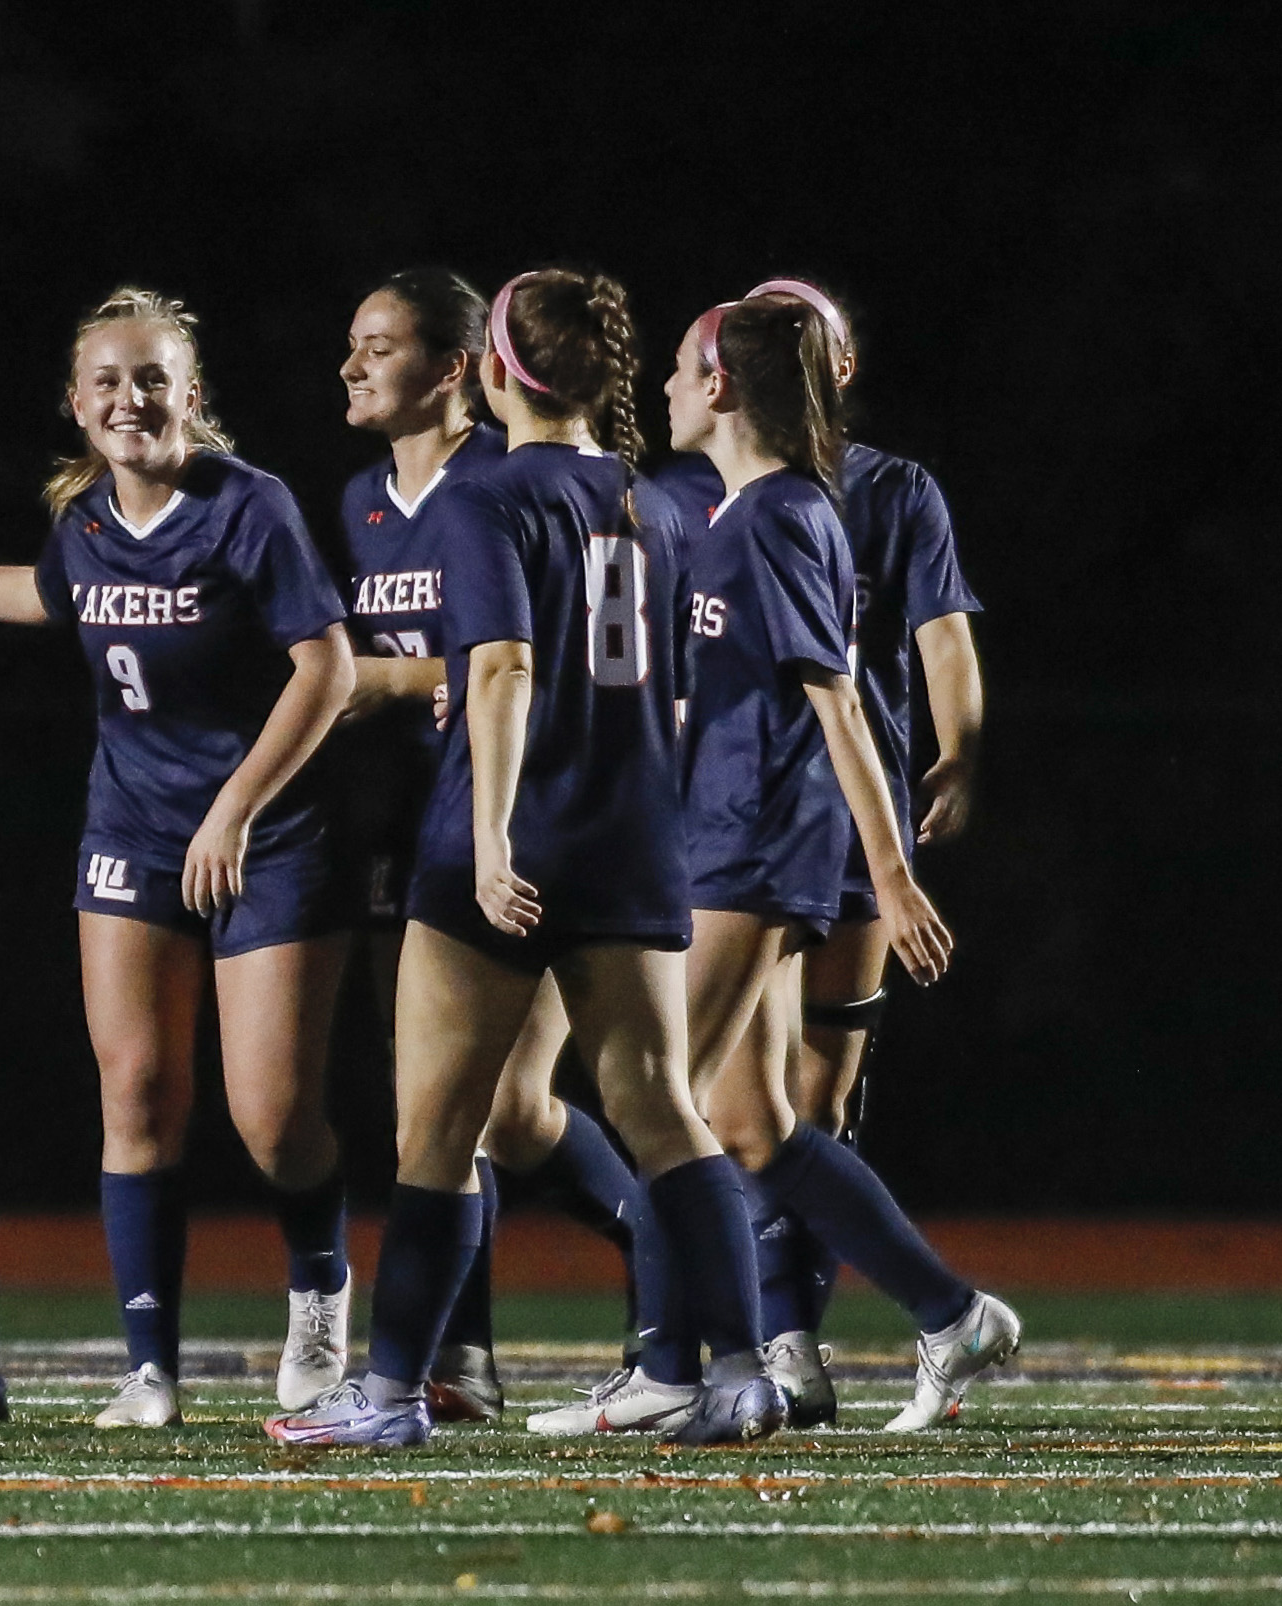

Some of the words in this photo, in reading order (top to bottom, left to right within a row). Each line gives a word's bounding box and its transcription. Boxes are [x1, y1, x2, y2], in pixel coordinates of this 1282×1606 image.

[352, 569, 442, 613] AKER
[586, 532, 650, 686] 8
[106, 644, 150, 712] 9
